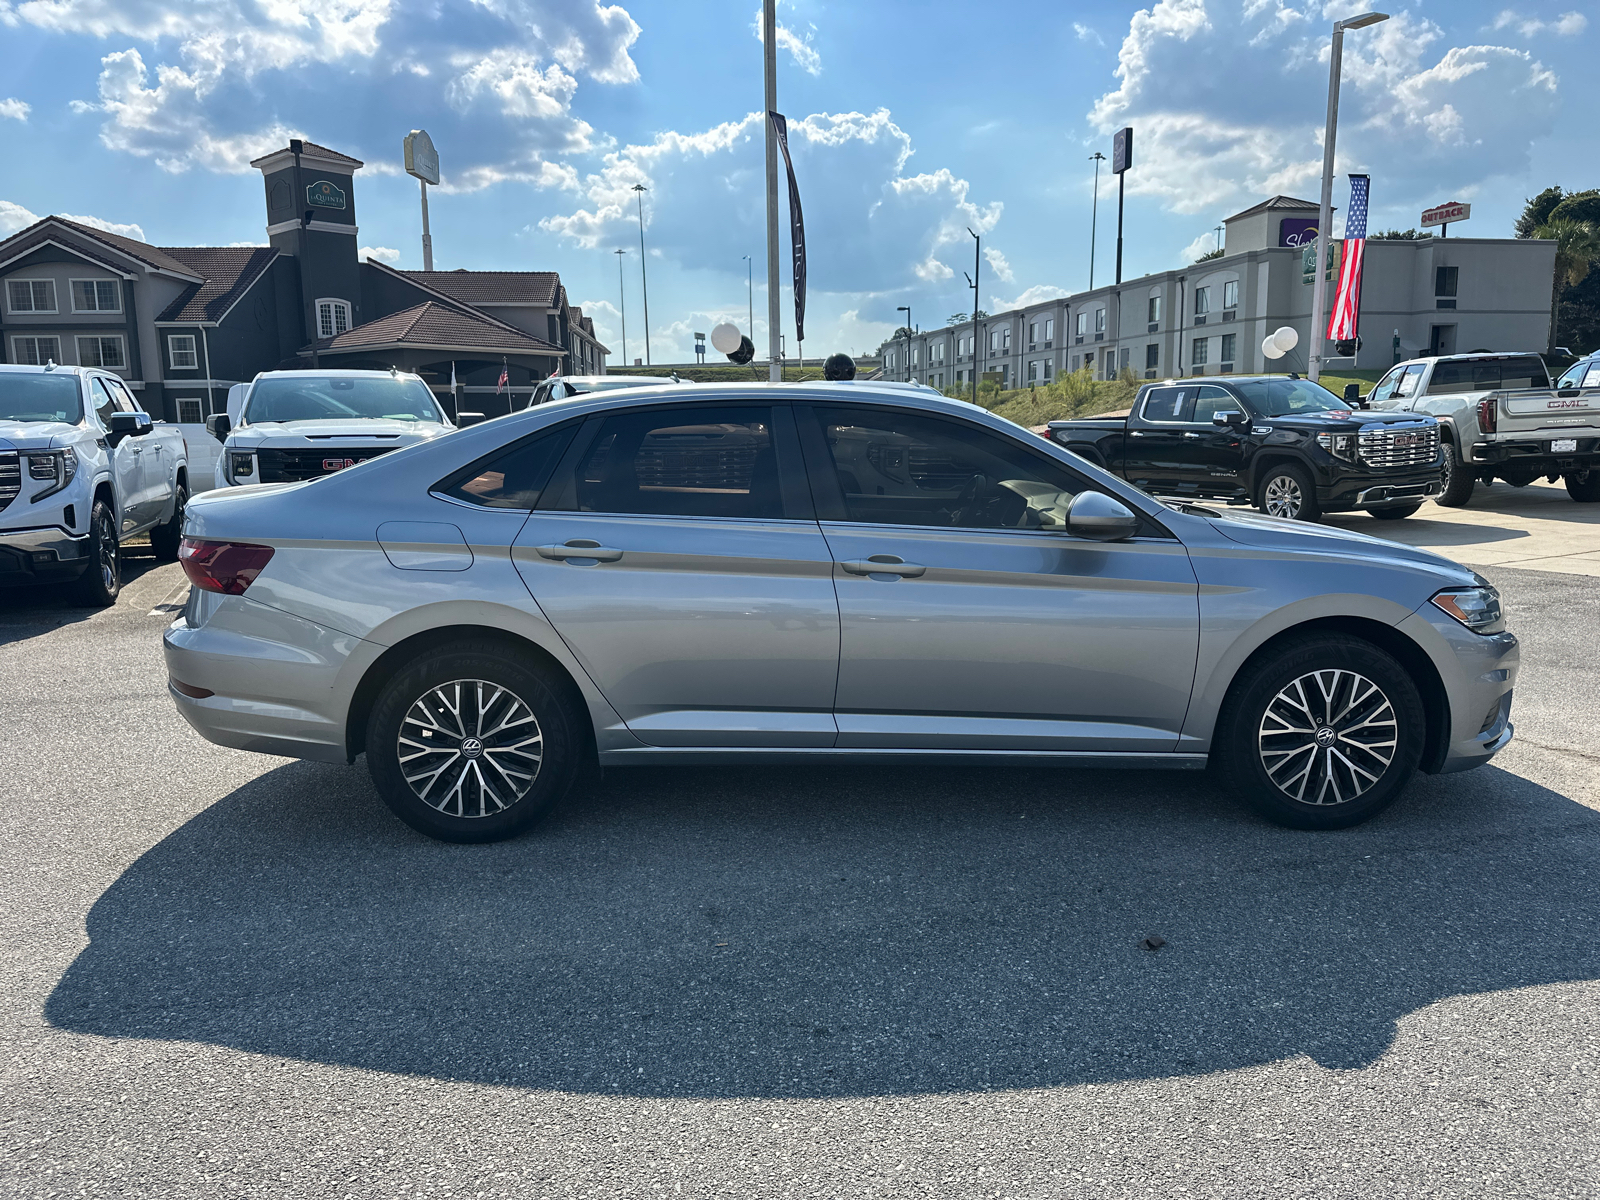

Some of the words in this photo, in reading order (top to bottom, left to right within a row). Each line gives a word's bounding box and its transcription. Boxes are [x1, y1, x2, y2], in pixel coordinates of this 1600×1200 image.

[316, 194, 344, 203] QUINTA
[1421, 207, 1464, 223] OUTBACK
[1286, 234, 1314, 248] Slee
[1547, 400, 1589, 408] GMC
